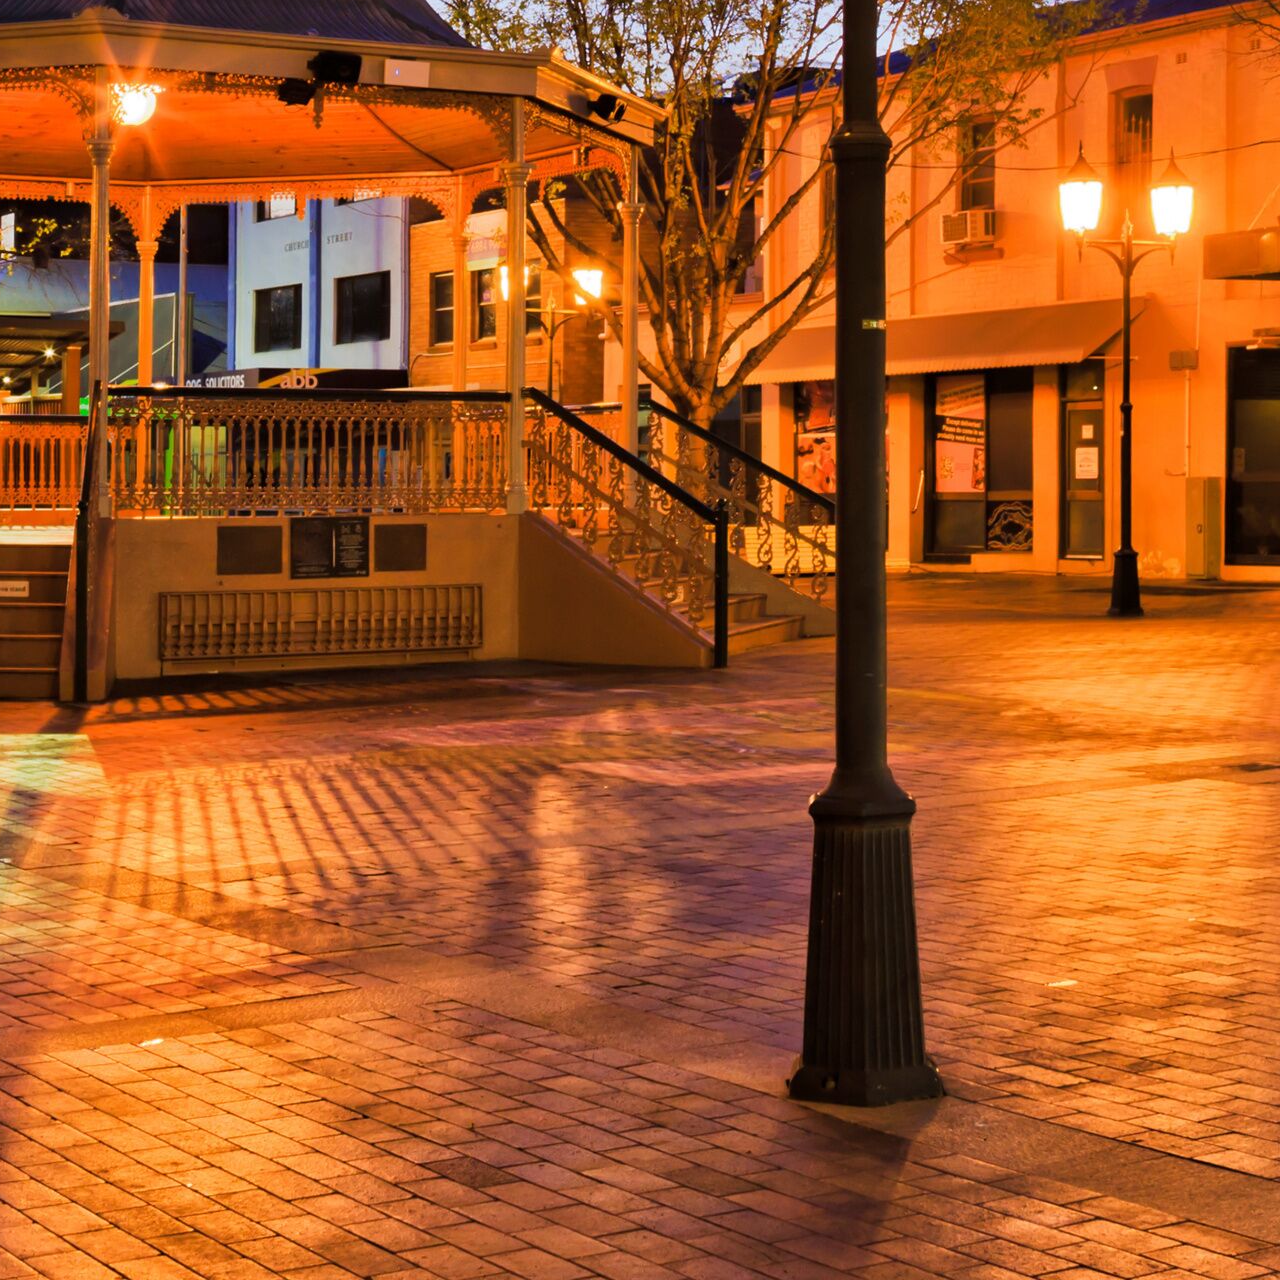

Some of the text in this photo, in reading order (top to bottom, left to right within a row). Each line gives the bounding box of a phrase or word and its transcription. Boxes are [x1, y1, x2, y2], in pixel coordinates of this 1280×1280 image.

[326, 231, 353, 245] STREET
[205, 374, 245, 388] SOLICITORS
[280, 367, 318, 389] abb
